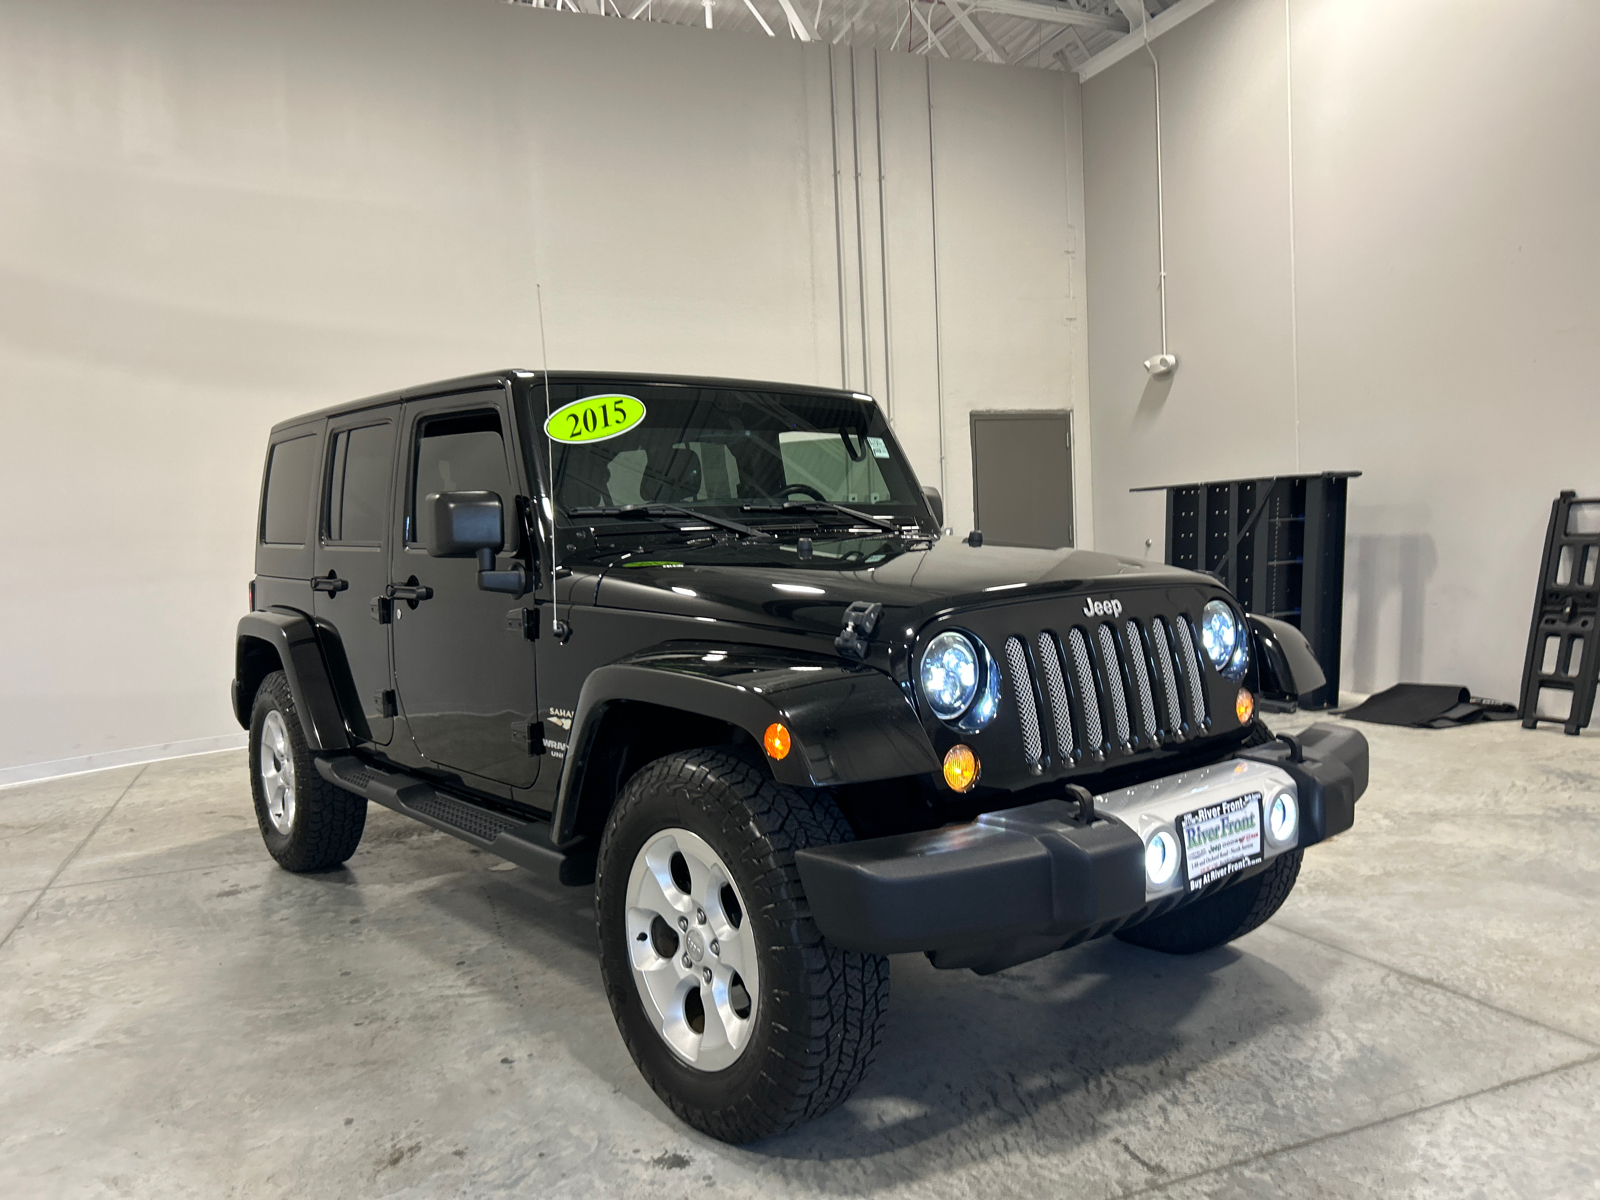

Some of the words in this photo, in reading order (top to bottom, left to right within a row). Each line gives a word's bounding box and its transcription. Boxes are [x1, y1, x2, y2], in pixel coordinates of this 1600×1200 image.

[566, 399, 627, 439] 2015
[1082, 597, 1122, 619] Jeep
[1198, 807, 1221, 822] River
[1190, 878, 1202, 891] Buy
[1203, 872, 1211, 885] At
[1210, 866, 1227, 882] River
